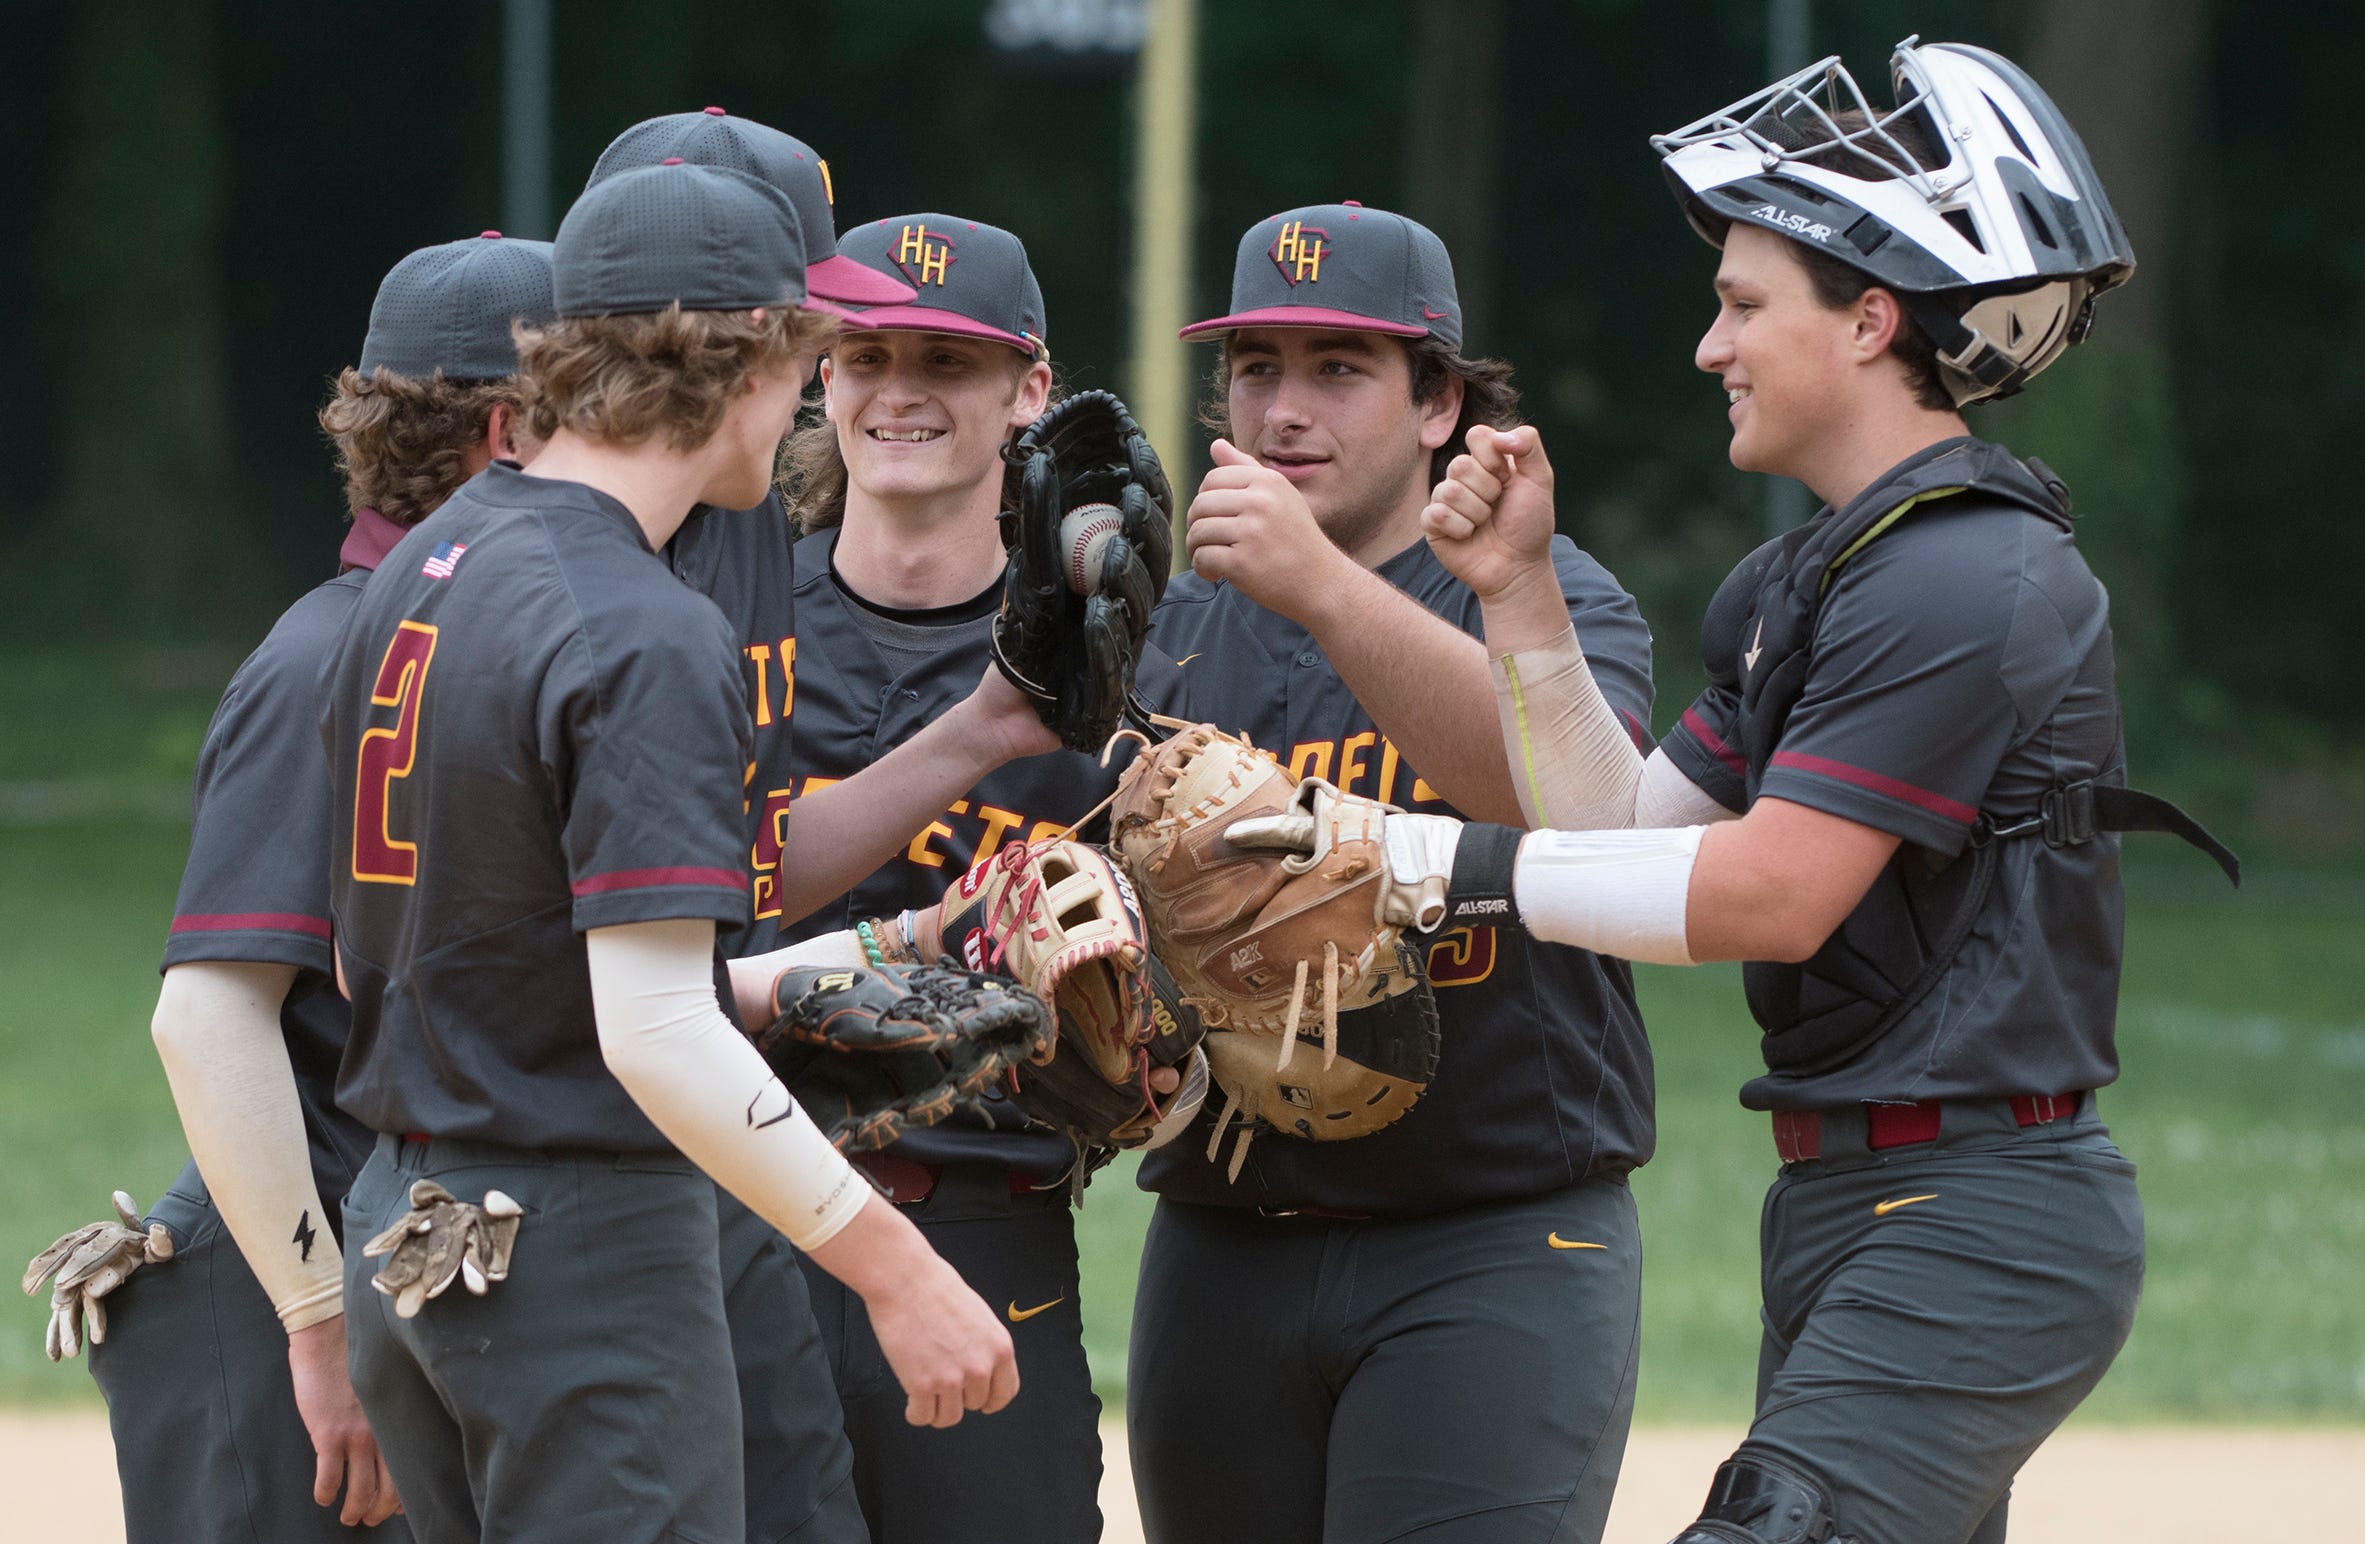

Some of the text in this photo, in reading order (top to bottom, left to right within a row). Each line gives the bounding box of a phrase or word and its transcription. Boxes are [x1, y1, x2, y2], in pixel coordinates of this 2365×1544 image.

[1750, 204, 1832, 243] ALL-STAR
[352, 619, 439, 886] 2
[1454, 899, 1509, 917] ALL-STAR
[1230, 941, 1264, 972] A2K
